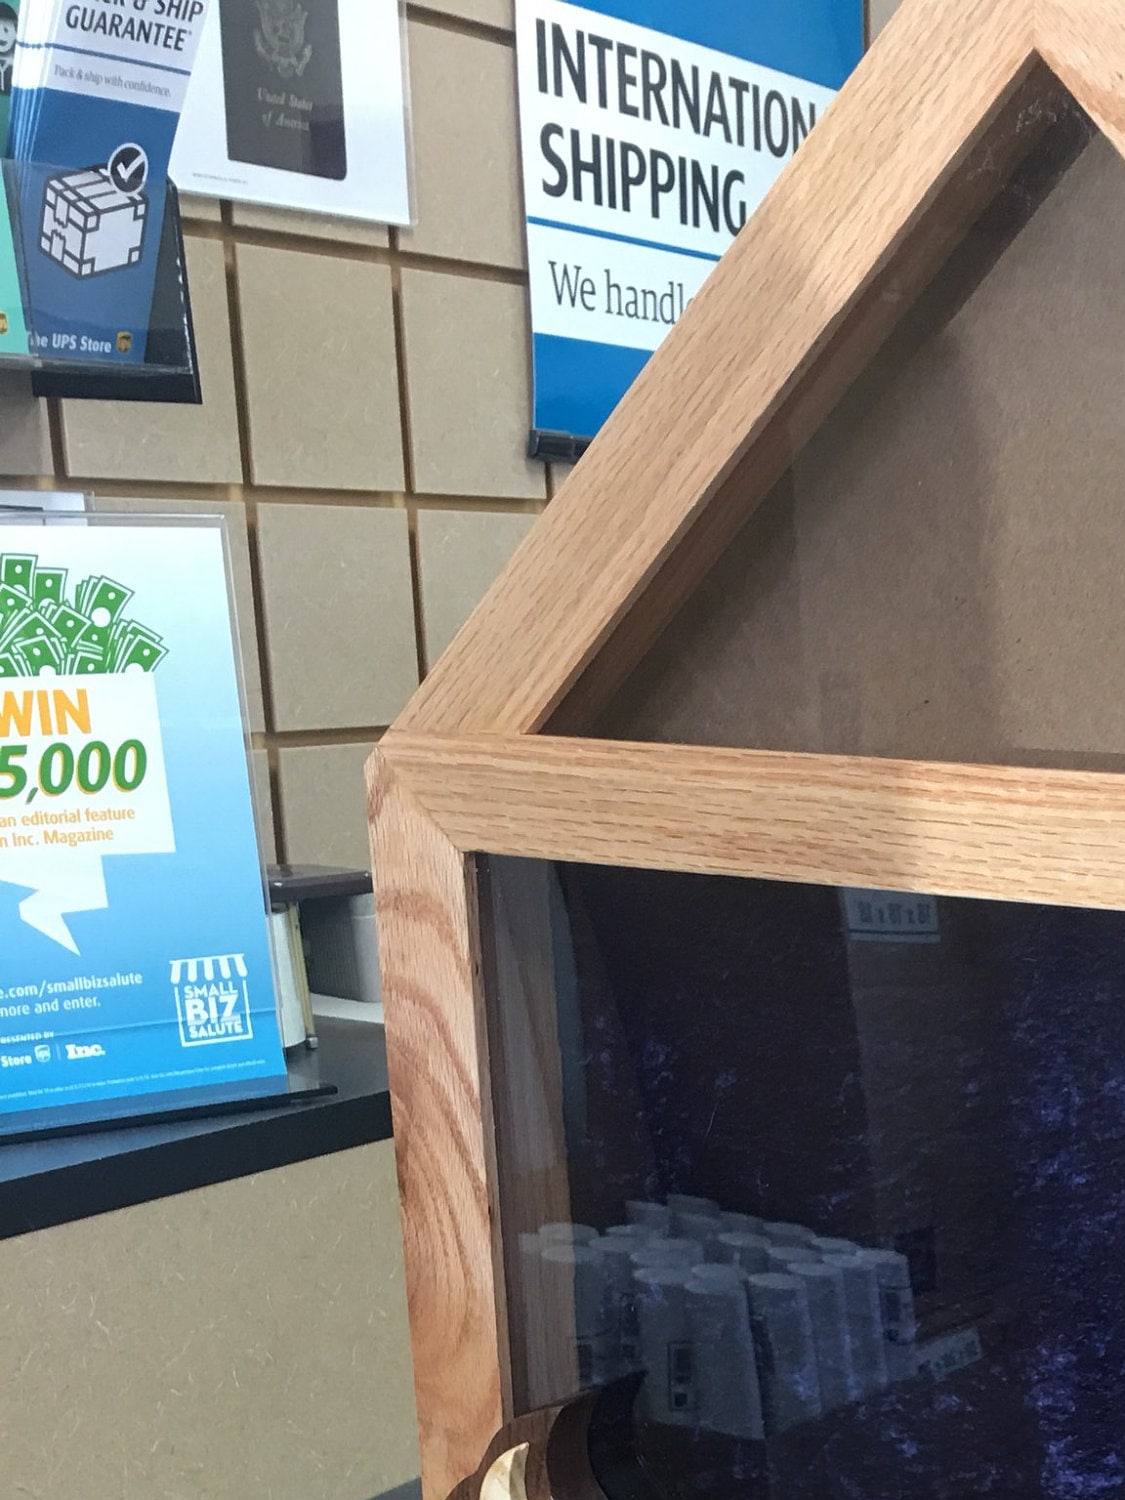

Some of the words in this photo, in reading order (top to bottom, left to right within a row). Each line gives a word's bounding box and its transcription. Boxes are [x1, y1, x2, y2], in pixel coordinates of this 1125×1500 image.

[65, 5, 187, 51] GUARANTEE
[84, 70, 103, 87] ship
[104, 75, 123, 89] with
[539, 121, 747, 238] SHIPPING
[548, 260, 597, 312] We
[52, 333, 78, 351] UPS
[80, 335, 112, 354] Store
[0, 688, 92, 738] WIN
[21, 808, 81, 827] editorial
[84, 807, 136, 823] feature
[12, 832, 39, 848] Inc.
[43, 827, 114, 848] Magazine
[184, 980, 239, 999] SMALL
[34, 997, 60, 1015] and
[63, 995, 101, 1011] enter.
[185, 994, 241, 1027] BIZ
[189, 1020, 244, 1040] SALUTE
[1, 1054, 33, 1068] Store
[65, 1043, 106, 1060] Inc.
